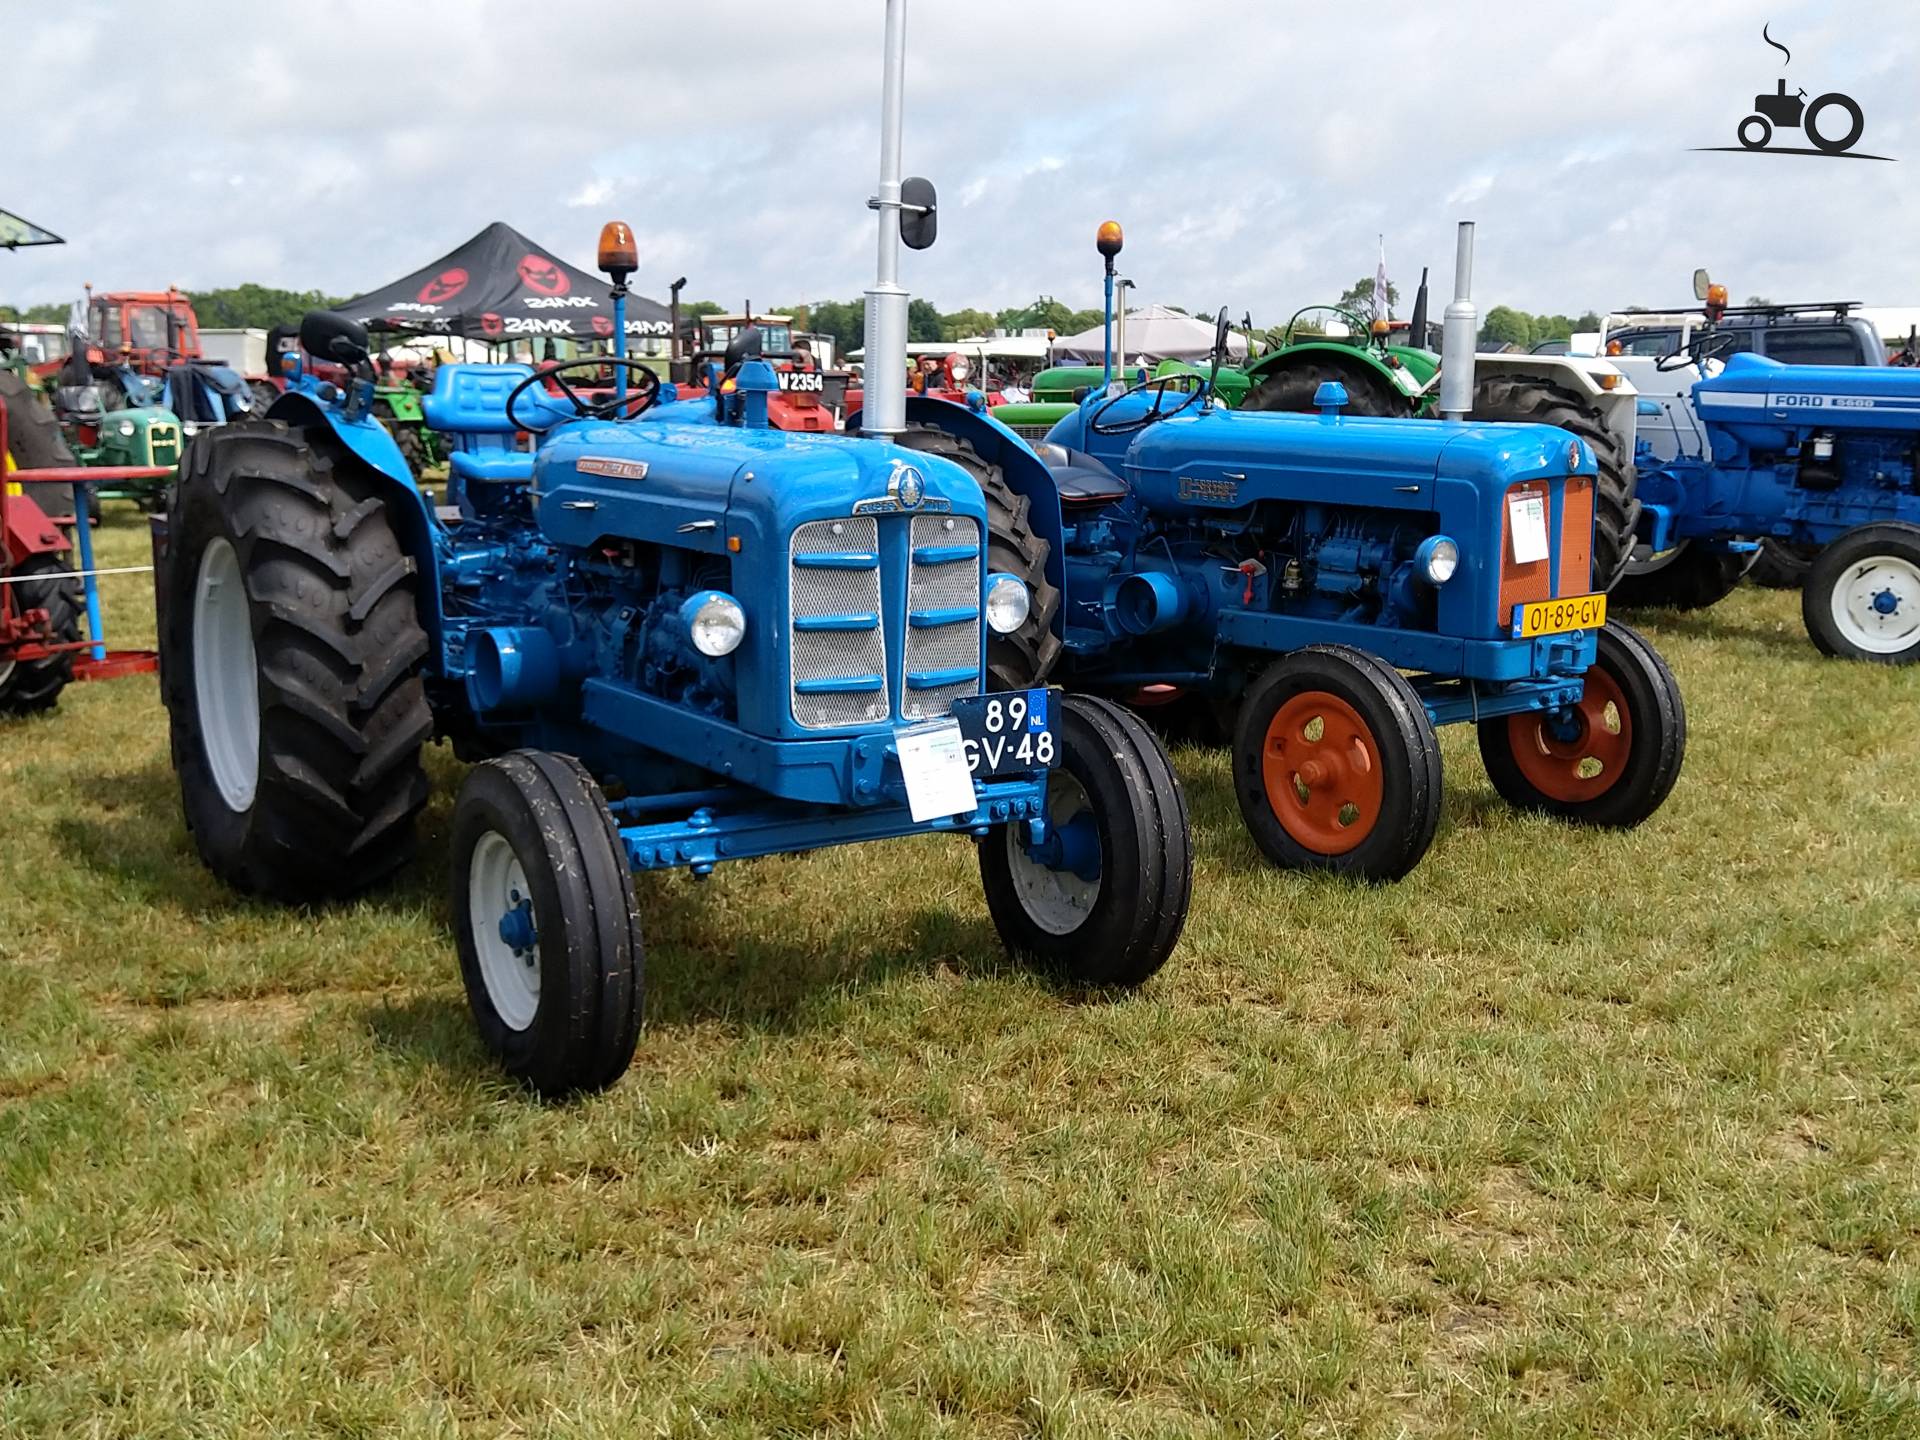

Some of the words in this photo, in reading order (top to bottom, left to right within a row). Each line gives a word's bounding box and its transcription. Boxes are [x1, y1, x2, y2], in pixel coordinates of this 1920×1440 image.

[503, 317, 575, 334] 24MX
[790, 373, 823, 391] 2354
[1775, 395, 1823, 407] FORD
[1530, 599, 1601, 632] 01-89-GV
[985, 697, 1027, 732] 89
[1030, 715, 1045, 726] NL
